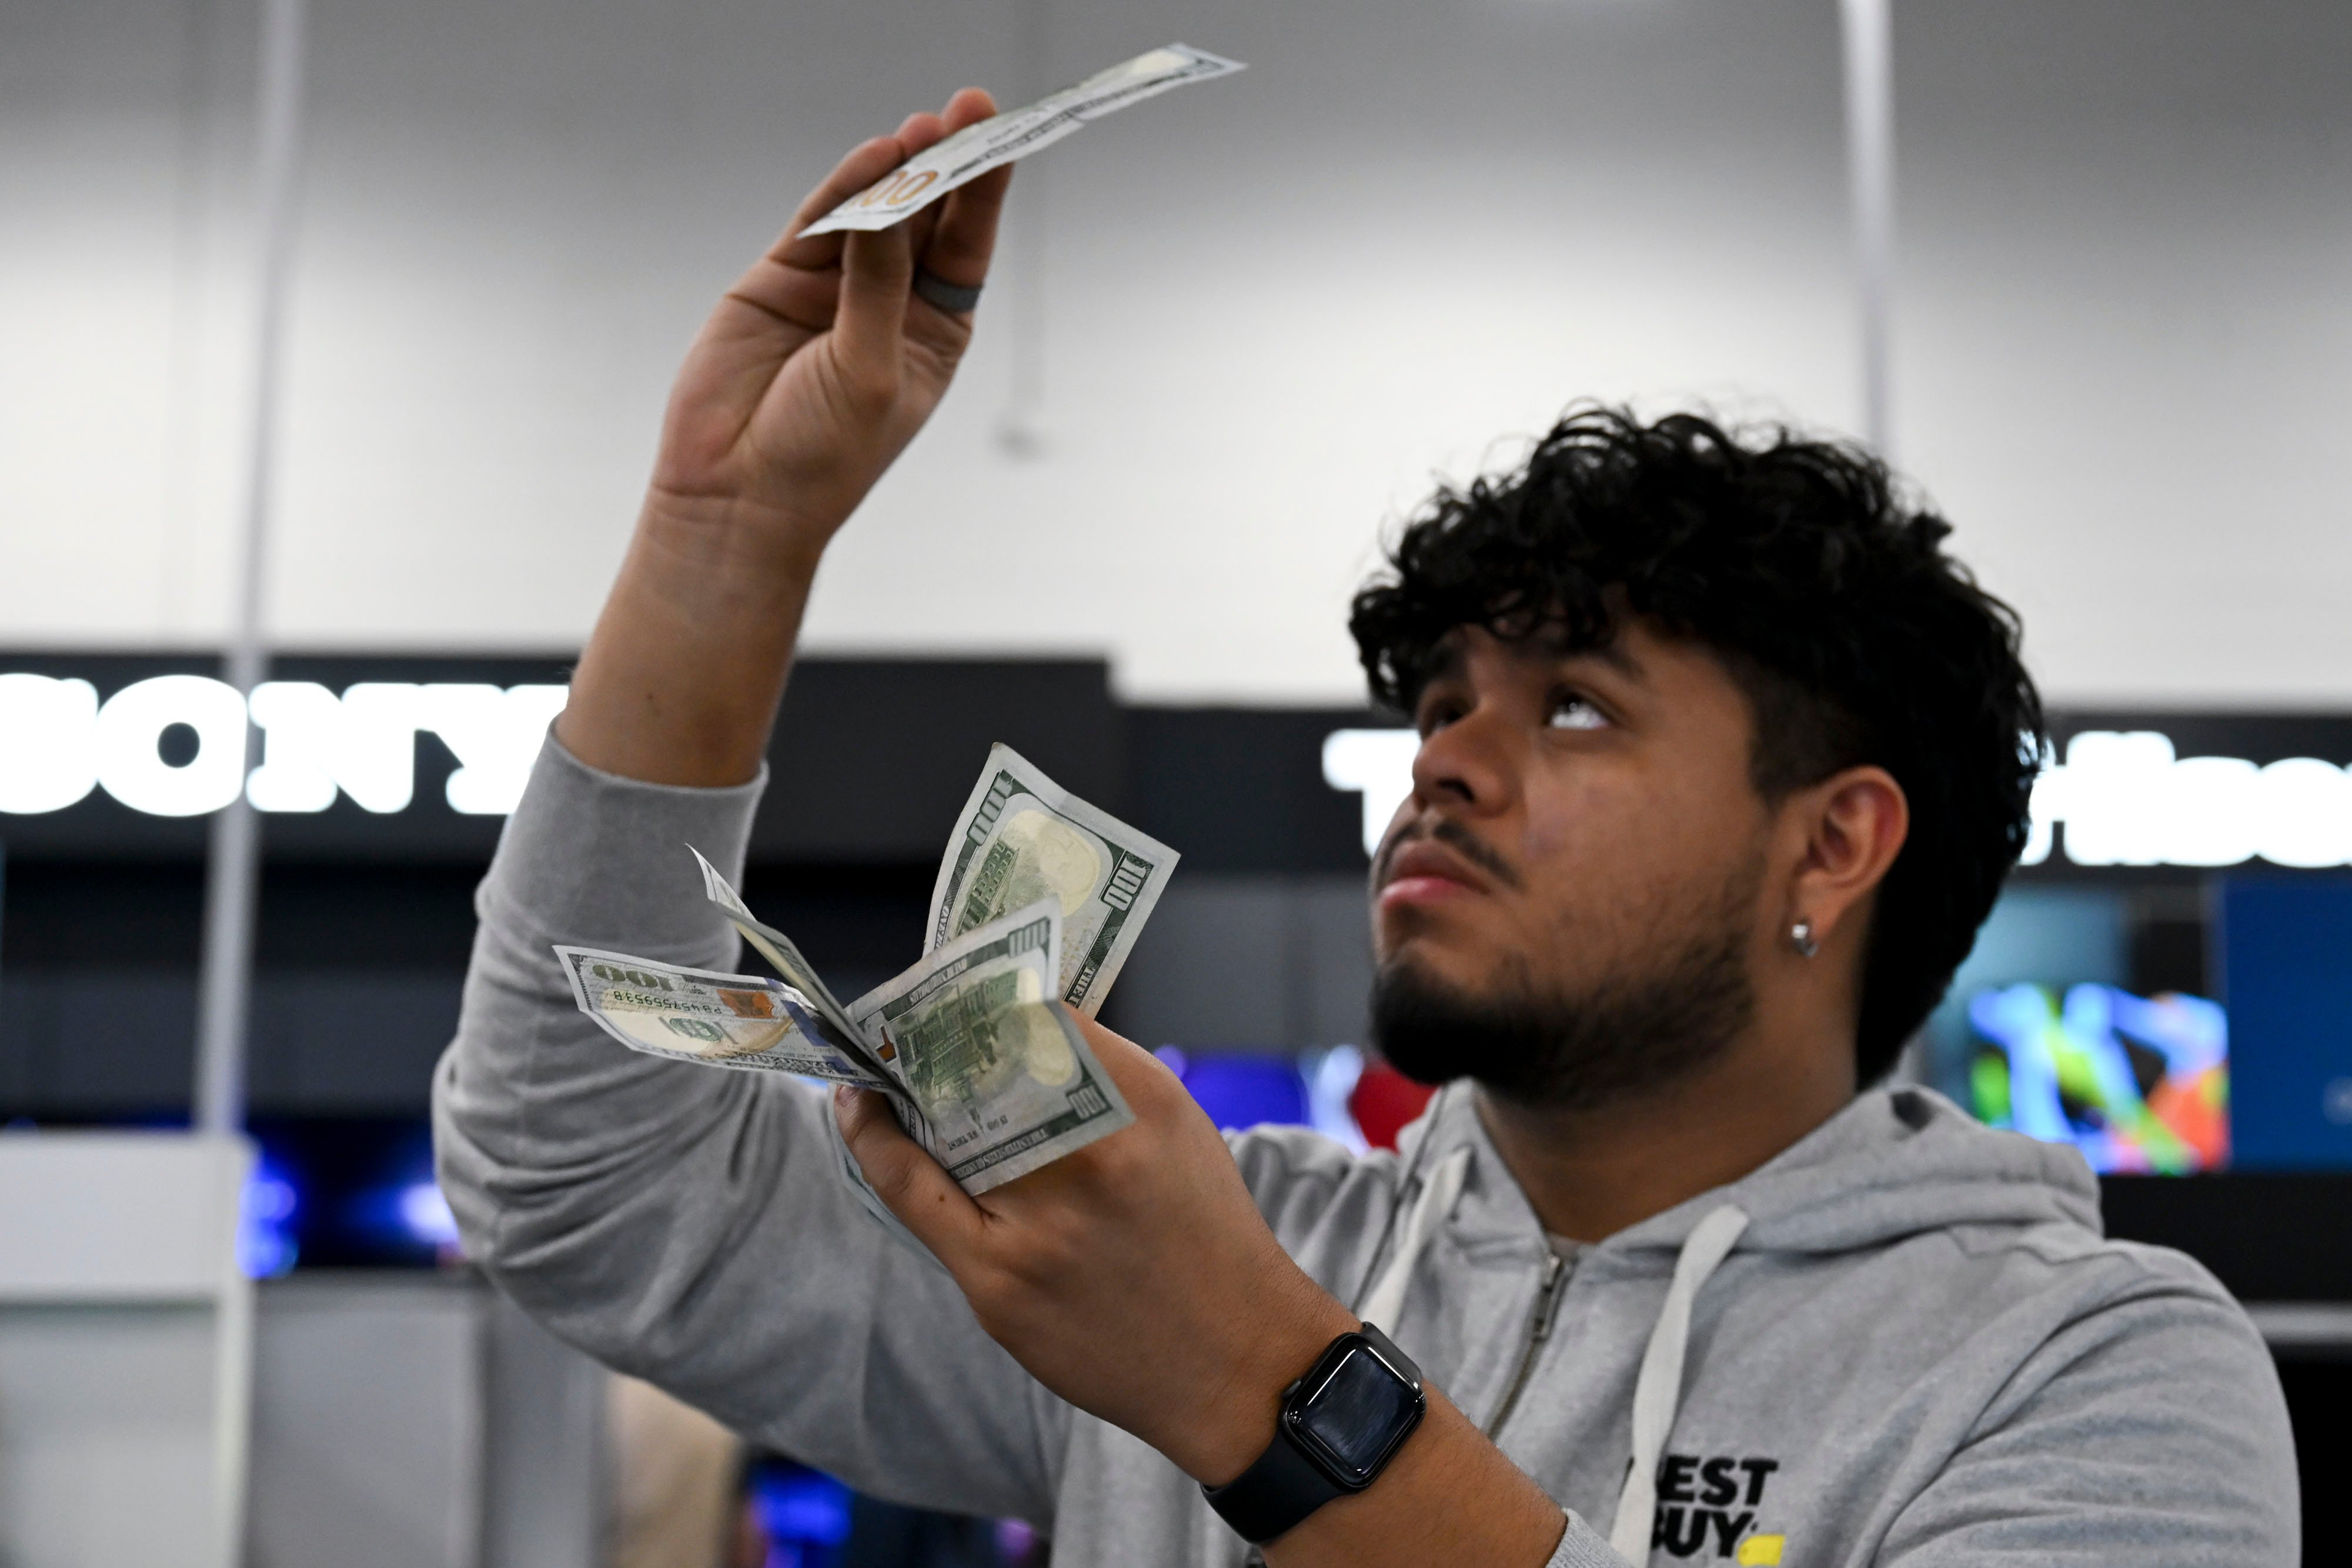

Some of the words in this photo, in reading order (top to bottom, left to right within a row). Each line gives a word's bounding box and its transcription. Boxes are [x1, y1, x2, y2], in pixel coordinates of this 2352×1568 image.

[0, 674, 569, 817] SONY
[592, 964, 674, 992] 100
[613, 990, 723, 1014] PB45755953B
[1620, 1455, 1779, 1506] EST
